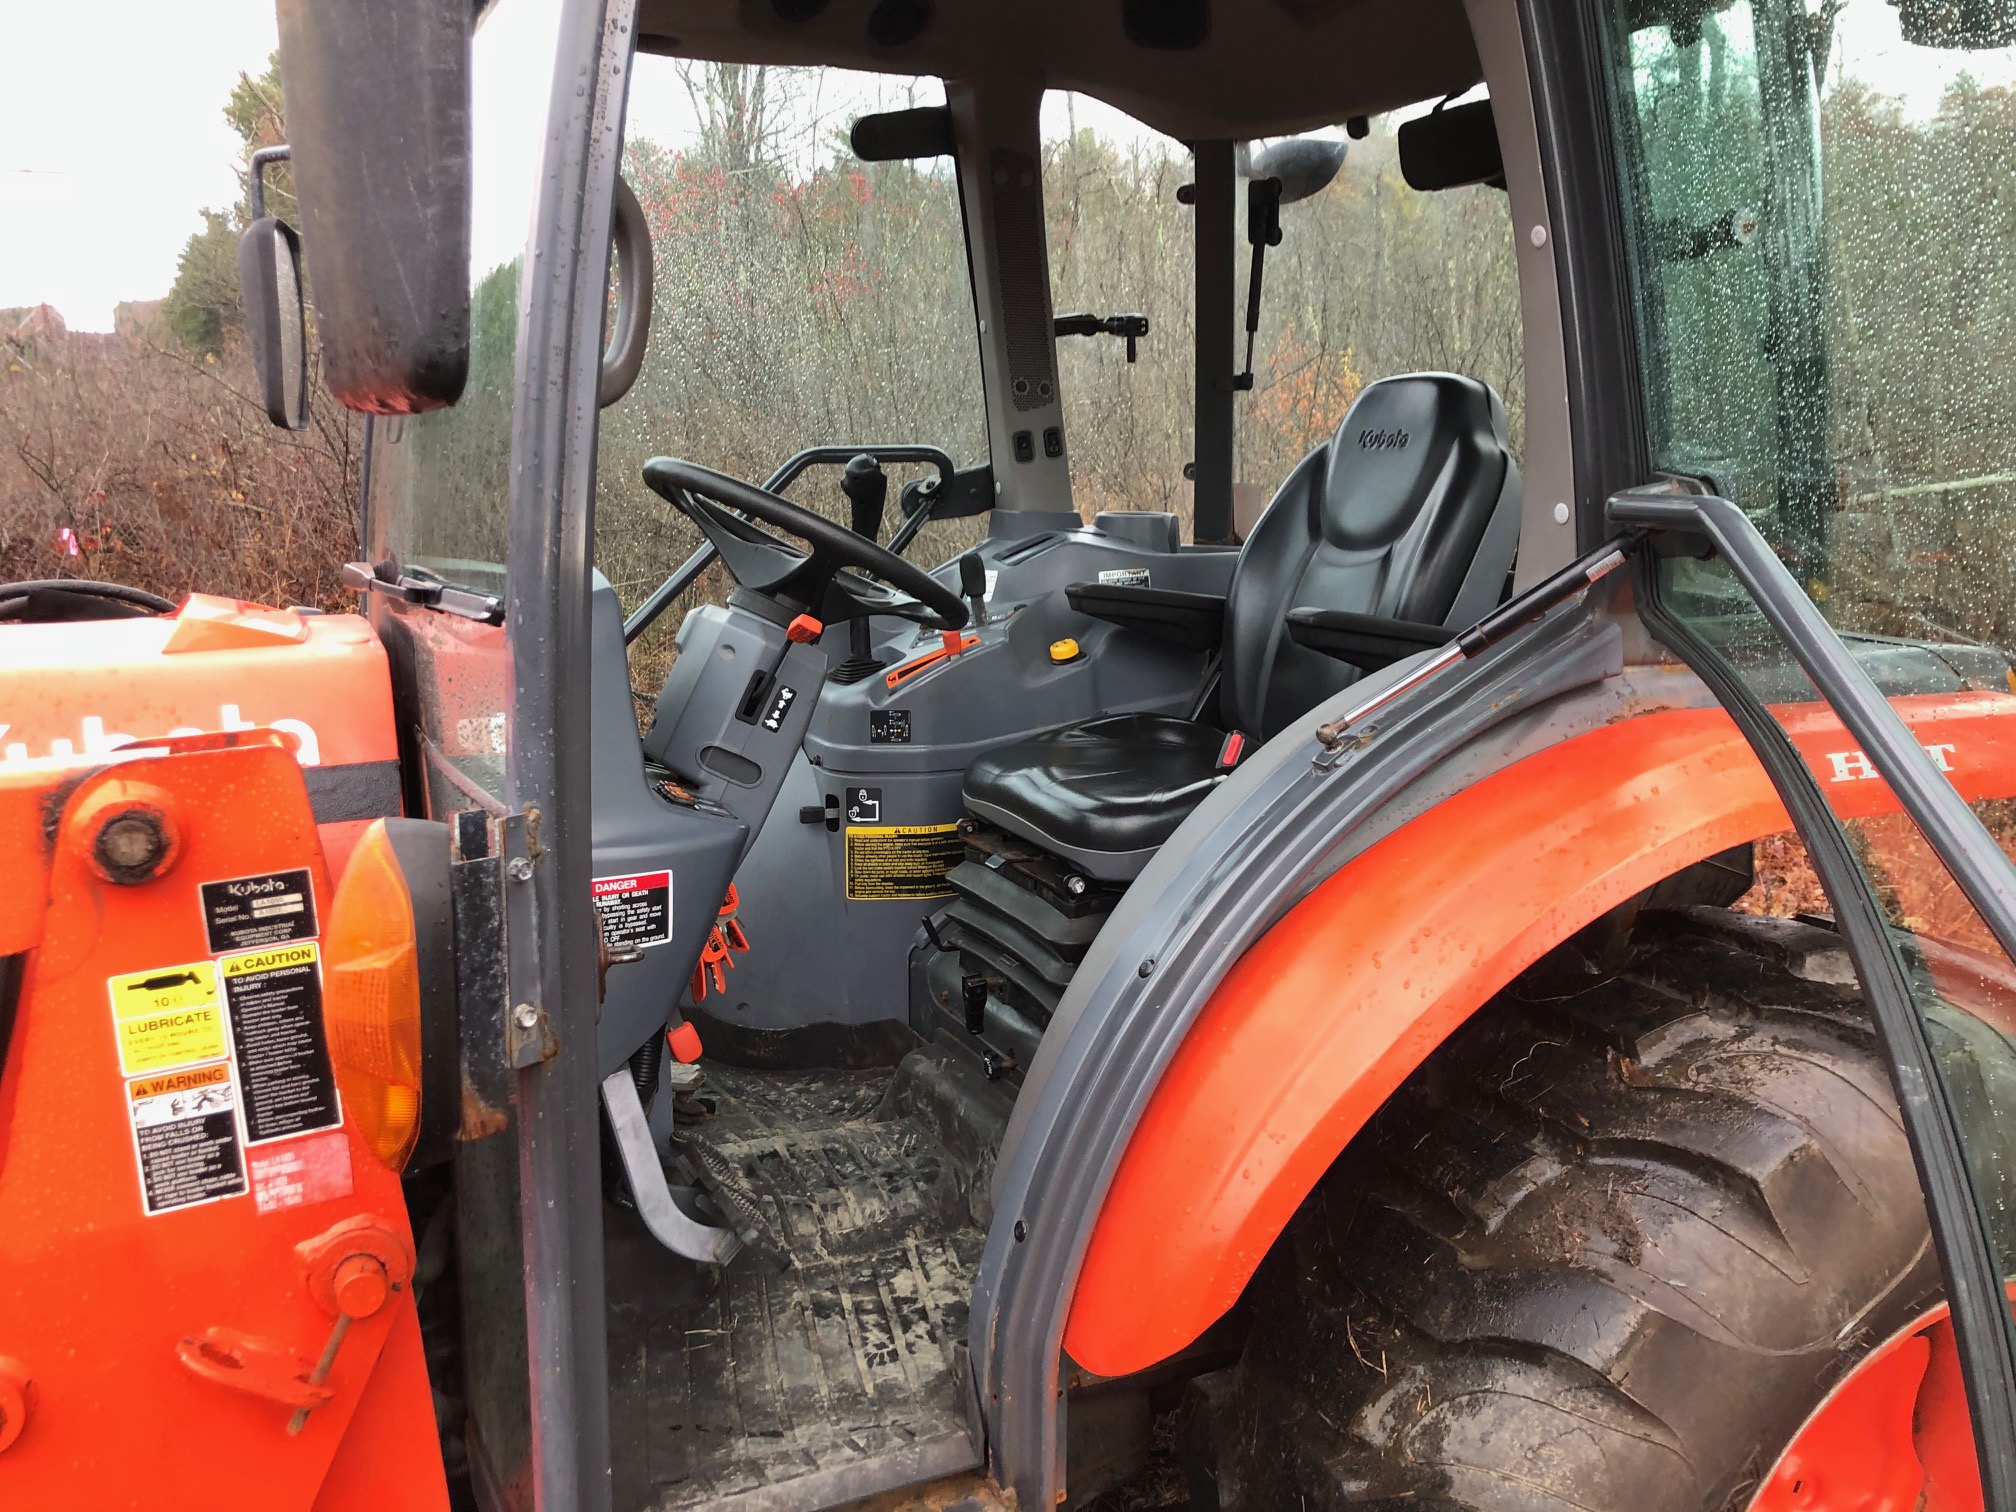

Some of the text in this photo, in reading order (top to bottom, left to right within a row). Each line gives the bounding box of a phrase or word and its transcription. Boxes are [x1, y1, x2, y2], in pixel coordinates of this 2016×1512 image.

[1358, 428, 1410, 451] Kubota
[1103, 570, 1145, 579] IMPORTANT
[1825, 744, 1956, 783] HT
[228, 879, 285, 896] Kubota
[595, 880, 637, 892] DANGER
[216, 905, 239, 913] Model
[596, 899, 622, 907] RUNAWAY.
[216, 916, 237, 924] Serial
[231, 921, 295, 936] KUBOTA INDUSTRIAL
[235, 932, 272, 941] EQUIPMENT
[240, 937, 279, 946] JEFFERSON,
[244, 949, 311, 969] CAUTION
[244, 972, 269, 982] AVOID
[269, 965, 310, 978] PERSONAL
[233, 982, 262, 992] INJURY
[154, 997, 169, 1007] 10
[128, 1011, 212, 1035] LUBRICATE
[151, 1069, 224, 1093] WARNING
[151, 1123, 176, 1133] AVOID
[176, 1117, 206, 1128] INJURY
[139, 1133, 164, 1143] FROM
[164, 1128, 190, 1138] FALLS
[140, 1132, 209, 1151] BEING CRUSHED:
